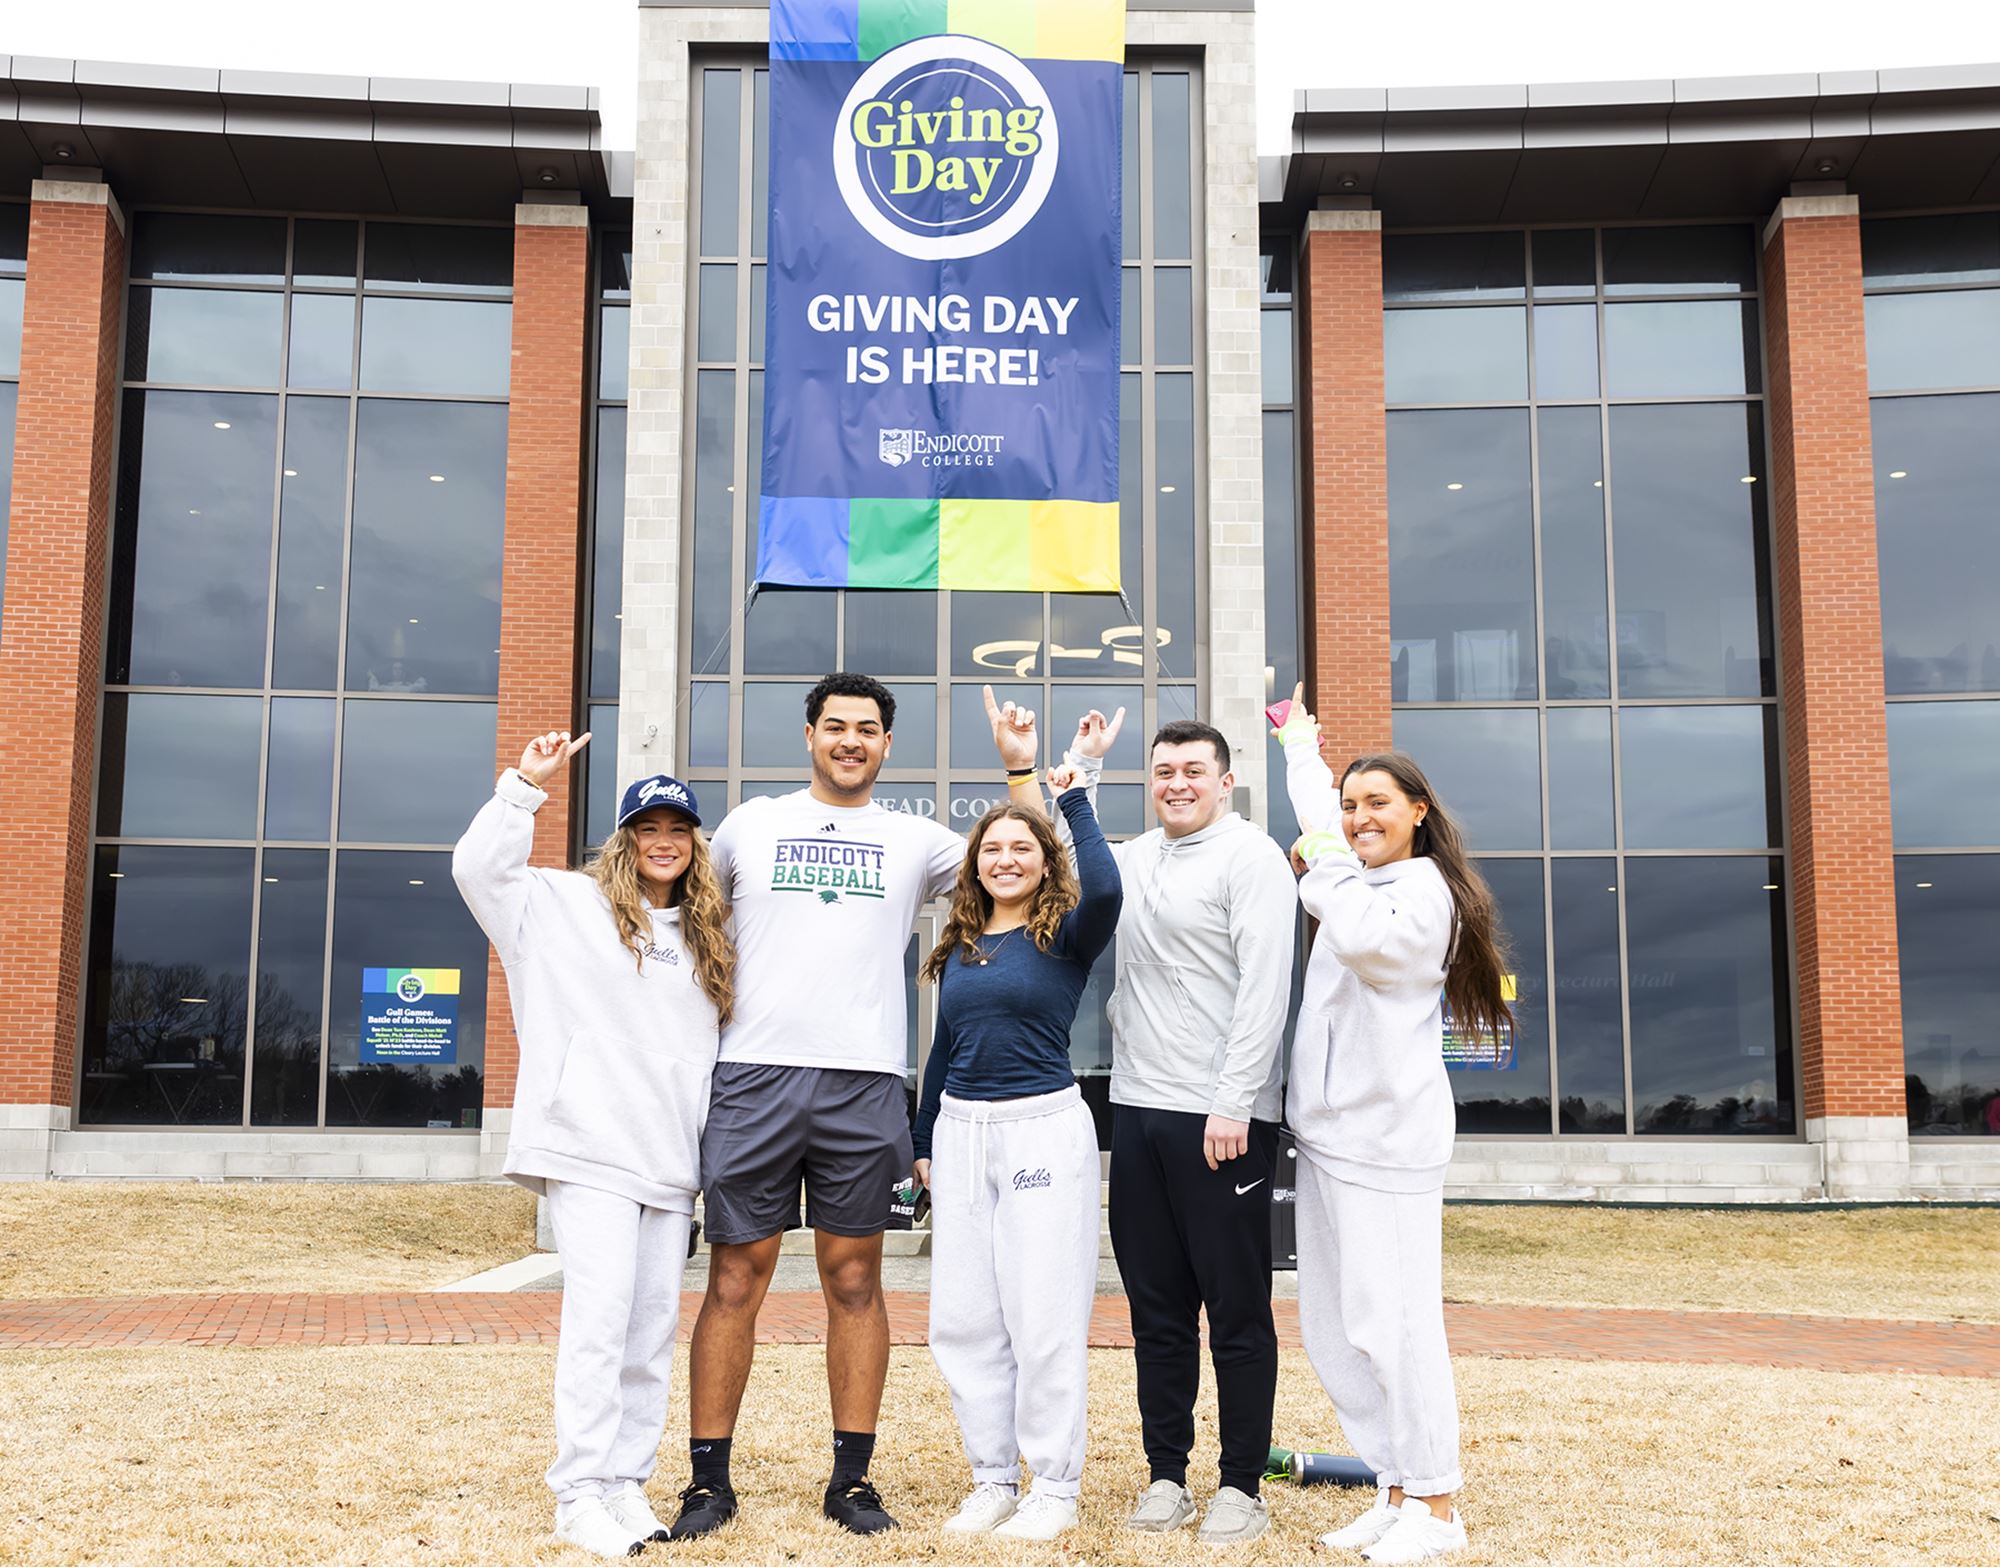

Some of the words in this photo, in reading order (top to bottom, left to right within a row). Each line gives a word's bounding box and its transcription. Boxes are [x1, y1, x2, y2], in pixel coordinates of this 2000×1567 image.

[853, 96, 1042, 156] Giving
[890, 149, 1003, 204] Day
[807, 294, 971, 333] GIVING
[983, 296, 1080, 335] DAY
[846, 346, 890, 384] IS
[902, 346, 1039, 386] HERE!
[913, 430, 1004, 454] ENDICOTT
[922, 455, 995, 468] COLLEGE
[638, 779, 689, 806] Gulls
[774, 844, 885, 870] ENDICOTT
[771, 865, 886, 892] BASEBALL
[367, 1016, 391, 1024] Battle
[392, 1016, 400, 1024] of
[401, 1016, 414, 1024] the
[415, 1017, 452, 1025] Divisions
[386, 1008, 404, 1016] Gull
[404, 1008, 434, 1017] Games:
[1012, 1168, 1051, 1191] Gulls
